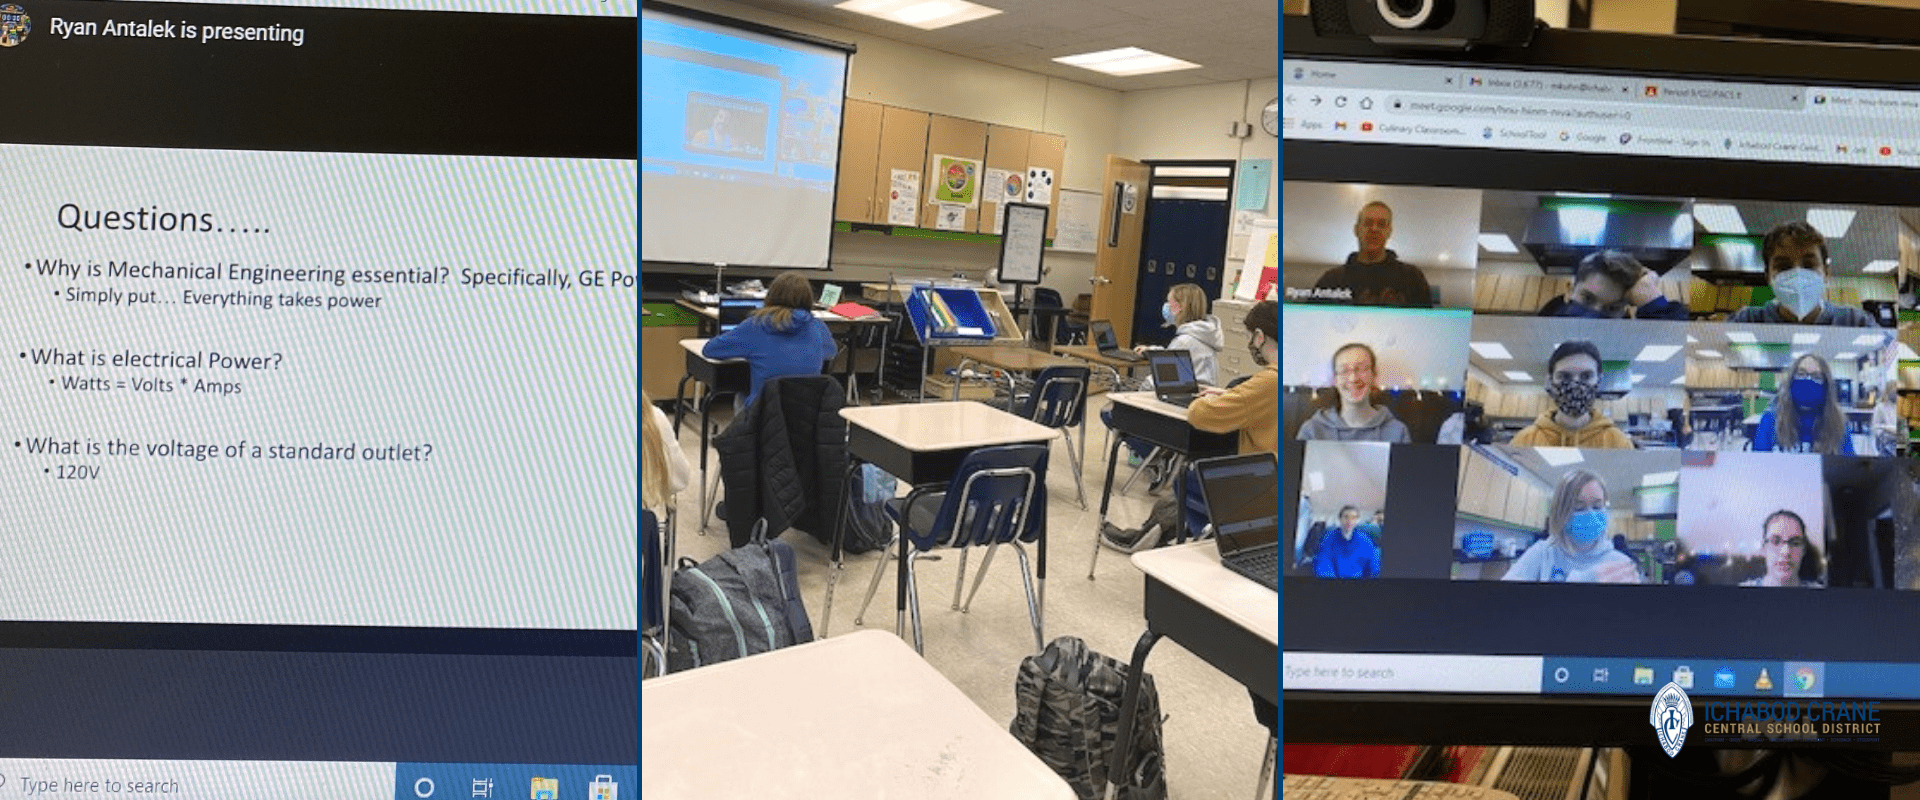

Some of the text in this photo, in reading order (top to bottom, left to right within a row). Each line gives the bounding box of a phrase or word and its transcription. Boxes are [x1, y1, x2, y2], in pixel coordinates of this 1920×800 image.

[50, 17, 304, 46] Ryan Antalek is presenting
[36, 259, 637, 291] Why is Mechanical Engineering essential? Specifically, GE Po
[66, 286, 123, 306] Simply
[183, 290, 273, 310] Everything
[278, 292, 322, 307] takes
[327, 296, 382, 310] power
[31, 348, 283, 371] What is electrical Power?
[61, 376, 110, 392] Watts
[131, 378, 174, 393] Volts
[193, 379, 242, 397] Amps
[26, 437, 432, 462] What is the voltage of a standard outlet?
[56, 464, 101, 480] 120V
[1286, 665, 1395, 679] Type here to search
[20, 776, 179, 796] Type here to search
